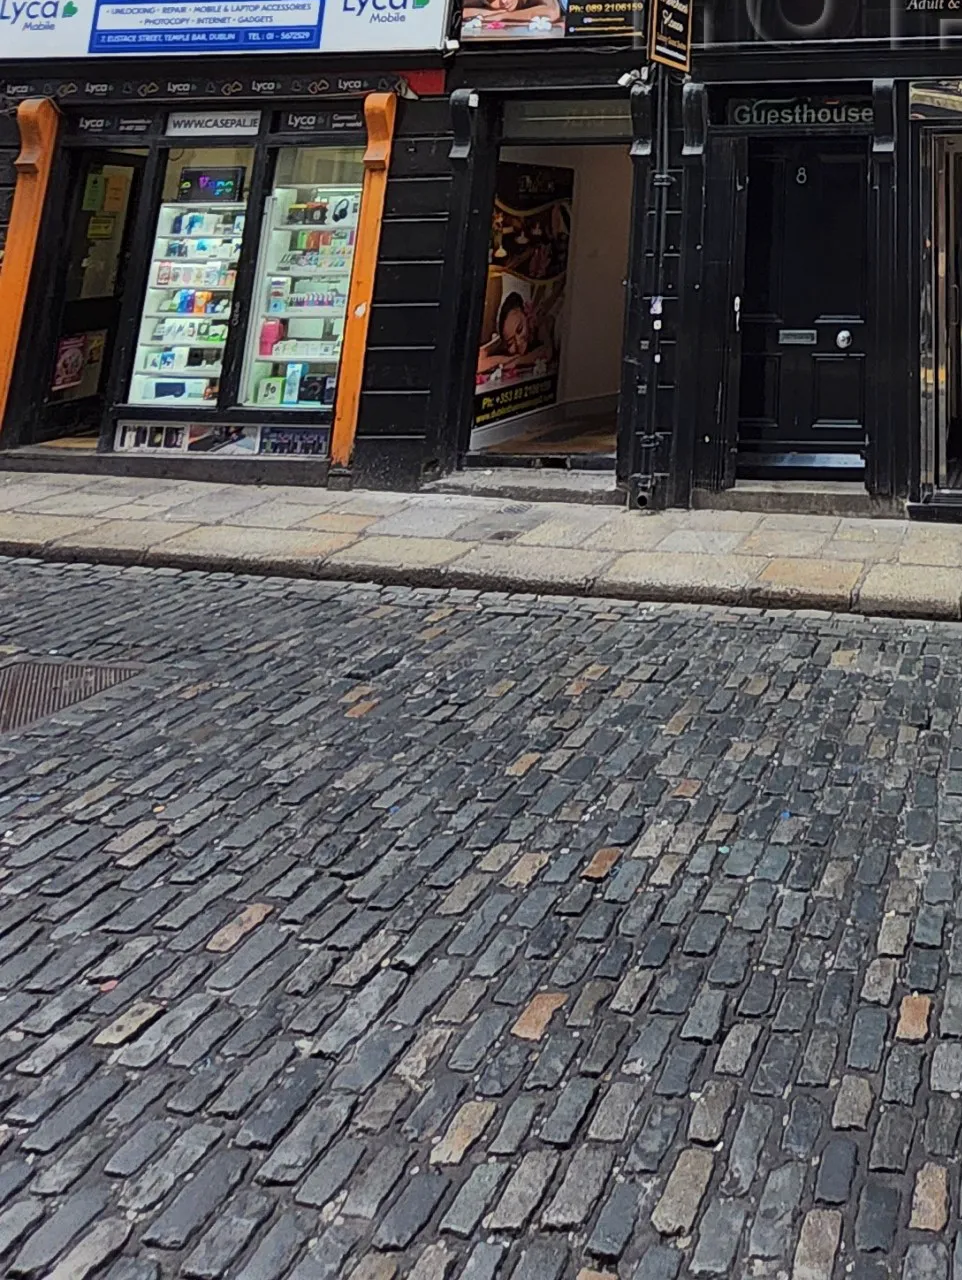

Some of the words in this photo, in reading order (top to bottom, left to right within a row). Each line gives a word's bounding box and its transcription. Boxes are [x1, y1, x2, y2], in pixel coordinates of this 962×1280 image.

[144, 17, 190, 26] PHOTOCOPY
[369, 12, 406, 23] Mobile
[22, 22, 56, 31] Mobile
[85, 82, 108, 93] Lyca
[167, 81, 190, 93] Lyca
[251, 80, 275, 92] Lyca
[338, 79, 361, 90] Lyca
[733, 103, 874, 125] Guesthouse
[79, 117, 105, 129] Lyca
[288, 114, 316, 127] Lyca
[795, 166, 809, 185] 8
